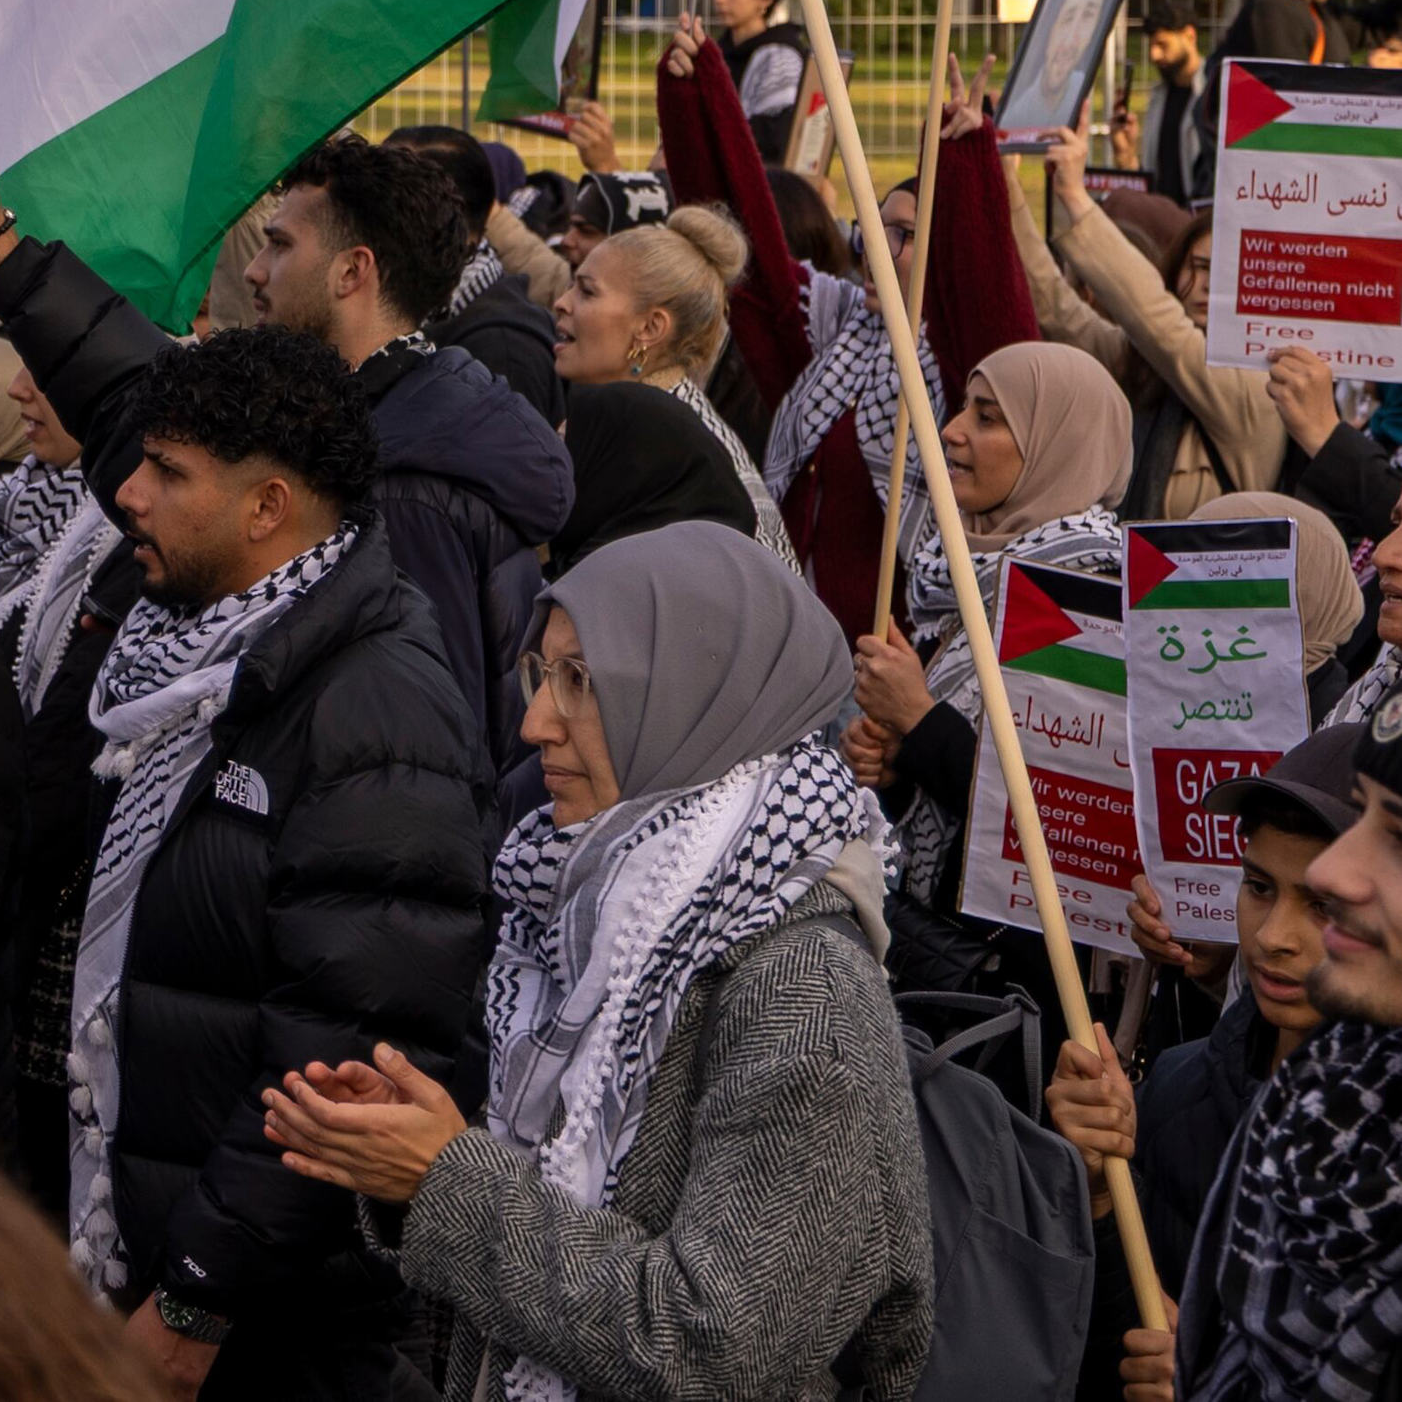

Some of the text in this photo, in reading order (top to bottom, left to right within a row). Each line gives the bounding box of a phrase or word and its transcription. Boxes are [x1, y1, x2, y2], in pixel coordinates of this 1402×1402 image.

[1236, 169, 1317, 210] الشهداء
[1245, 238, 1347, 258] Wir werden
[1243, 258, 1305, 274] unsere
[1242, 275, 1394, 298] Gefallenen nicht
[1241, 294, 1335, 312] vergessen
[1246, 322, 1314, 340] Free
[1245, 342, 1395, 368] Pstine
[1157, 625, 1267, 674] غزة
[1173, 692, 1253, 730] تنتصر
[228, 759, 250, 779] THE
[216, 770, 249, 794] ORTH
[216, 785, 247, 806] FACE
[1036, 804, 1086, 826] sere
[1012, 870, 1092, 904] Fee
[1175, 878, 1220, 896] Free
[1176, 901, 1236, 922] Pales
